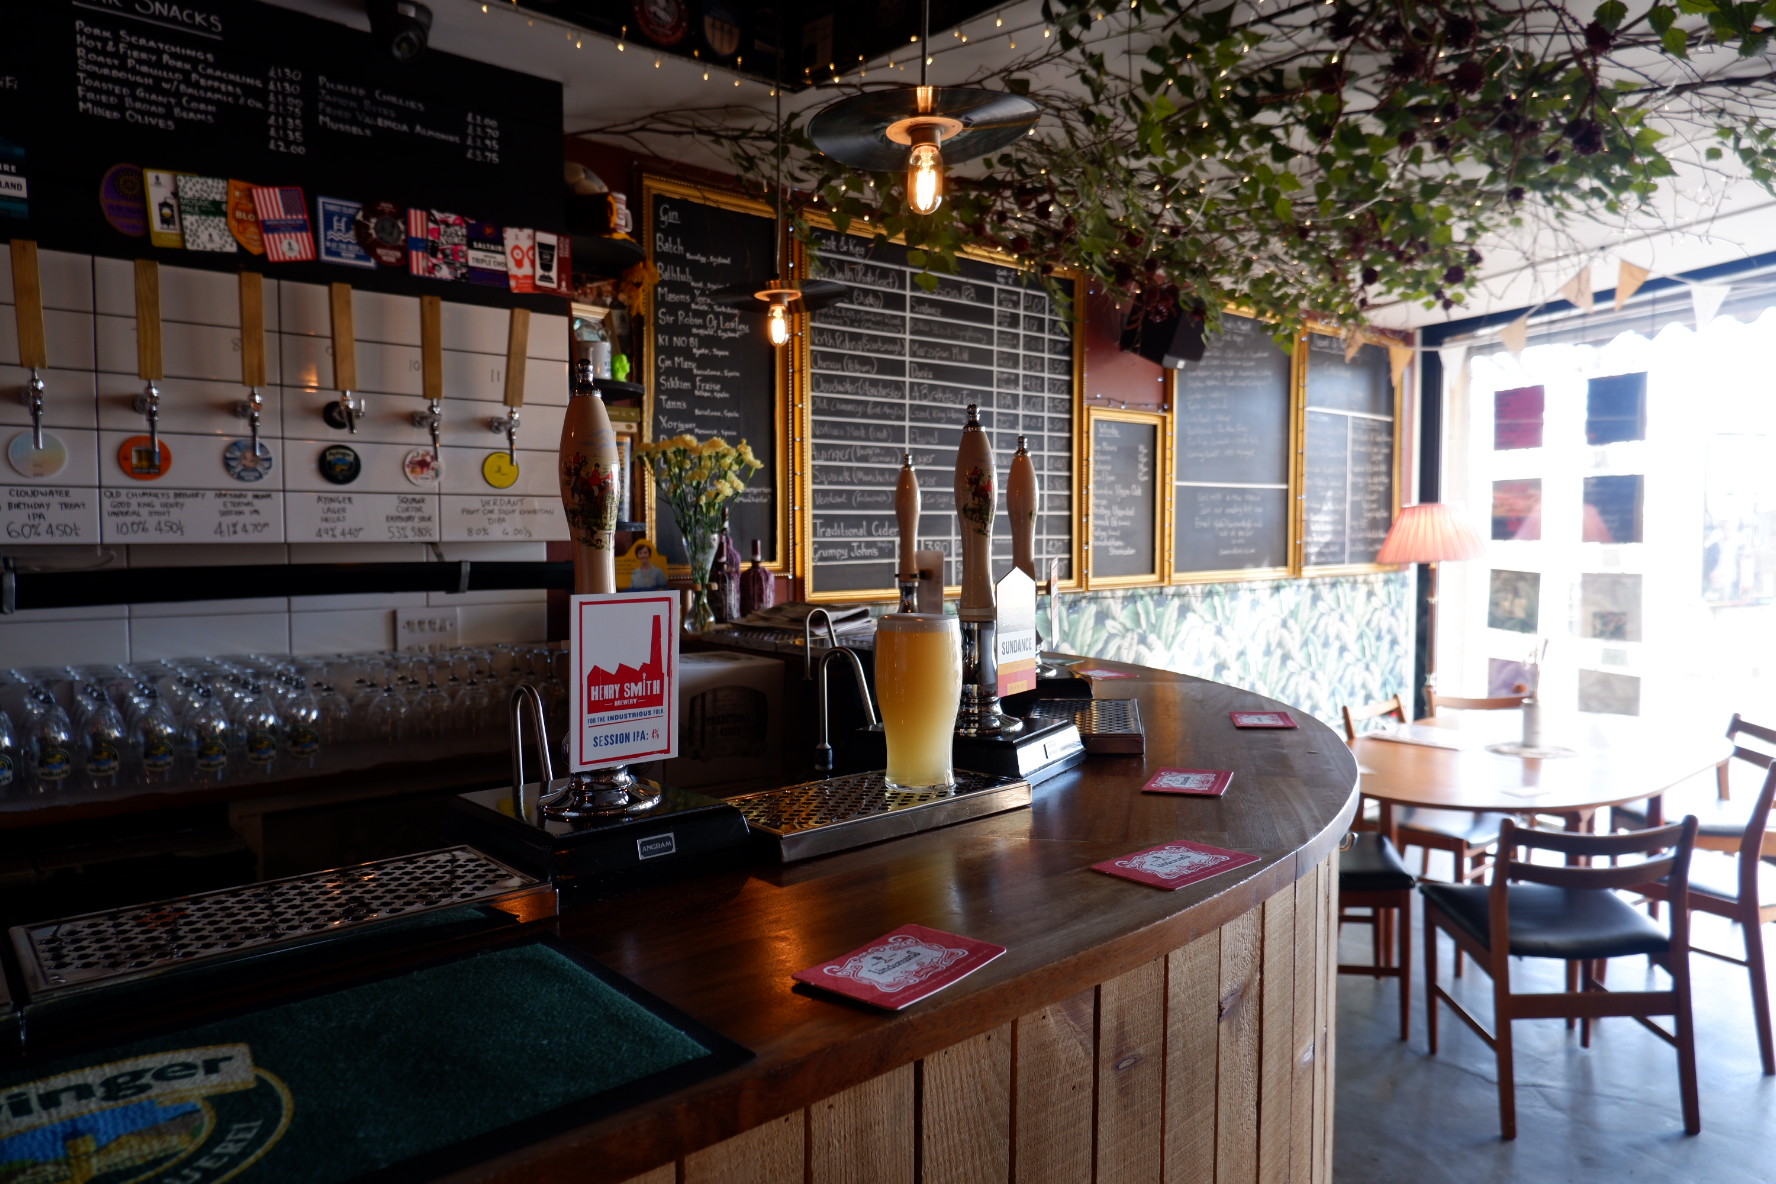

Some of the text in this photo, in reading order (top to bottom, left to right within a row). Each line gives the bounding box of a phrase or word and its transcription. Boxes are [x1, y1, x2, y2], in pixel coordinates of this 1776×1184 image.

[134, 0, 223, 33] SNACKS
[76, 19, 215, 63] PORK SCRATCHINGS
[76, 34, 103, 51] HOT
[119, 42, 157, 63] FIERY
[162, 53, 193, 72] PORK
[198, 62, 264, 89] CRACKLING
[77, 47, 120, 67] ROAST
[191, 72, 242, 96] PEPPERS
[78, 60, 154, 87] SOURDOUGH
[76, 72, 217, 114] TOASTED GIANT CORN
[318, 74, 426, 113] PICKLED CHILLIES
[78, 86, 215, 125] FRIED BROAD BEANS
[79, 101, 176, 132] MIXED OLIVES
[318, 102, 352, 120] FRIED
[356, 111, 411, 134] VALENCIA
[318, 113, 373, 137] MUSSELS
[659, 204, 681, 229] Gin
[656, 232, 685, 255] Batch
[656, 261, 693, 283] Bathtub
[657, 286, 691, 303] Masons
[658, 308, 675, 326] Sir
[678, 310, 704, 326] Robin
[719, 315, 752, 334] Loxley
[658, 335, 669, 347] KI
[673, 336, 688, 347] NO
[658, 355, 673, 372] Gin
[659, 376, 722, 392] Sikkim Fraise
[8, 489, 71, 499] CLOUDWATER
[104, 489, 121, 499] OLD
[126, 491, 171, 500] CHIMNEYS
[316, 495, 354, 505] AYINGER
[480, 498, 527, 508] VERDANT
[7, 502, 87, 511] BIRTHDAY TREAT
[110, 501, 132, 510] GOOD
[159, 502, 186, 510] HENRY
[321, 506, 347, 514] LAGER
[27, 513, 47, 521] IPA
[812, 519, 900, 538] Traditional Cider
[812, 543, 848, 562] Grumpy
[1001, 637, 1033, 655] SUNDANCE
[590, 684, 621, 702] HENRY
[614, 698, 639, 707] BREWERY
[587, 707, 664, 726] FOR THE INDUSTRIOUS FOLK
[593, 732, 631, 748] SESSION
[633, 730, 649, 743] IPA:
[642, 840, 672, 853] ANGRAM
[0, 1056, 234, 1118] inger
